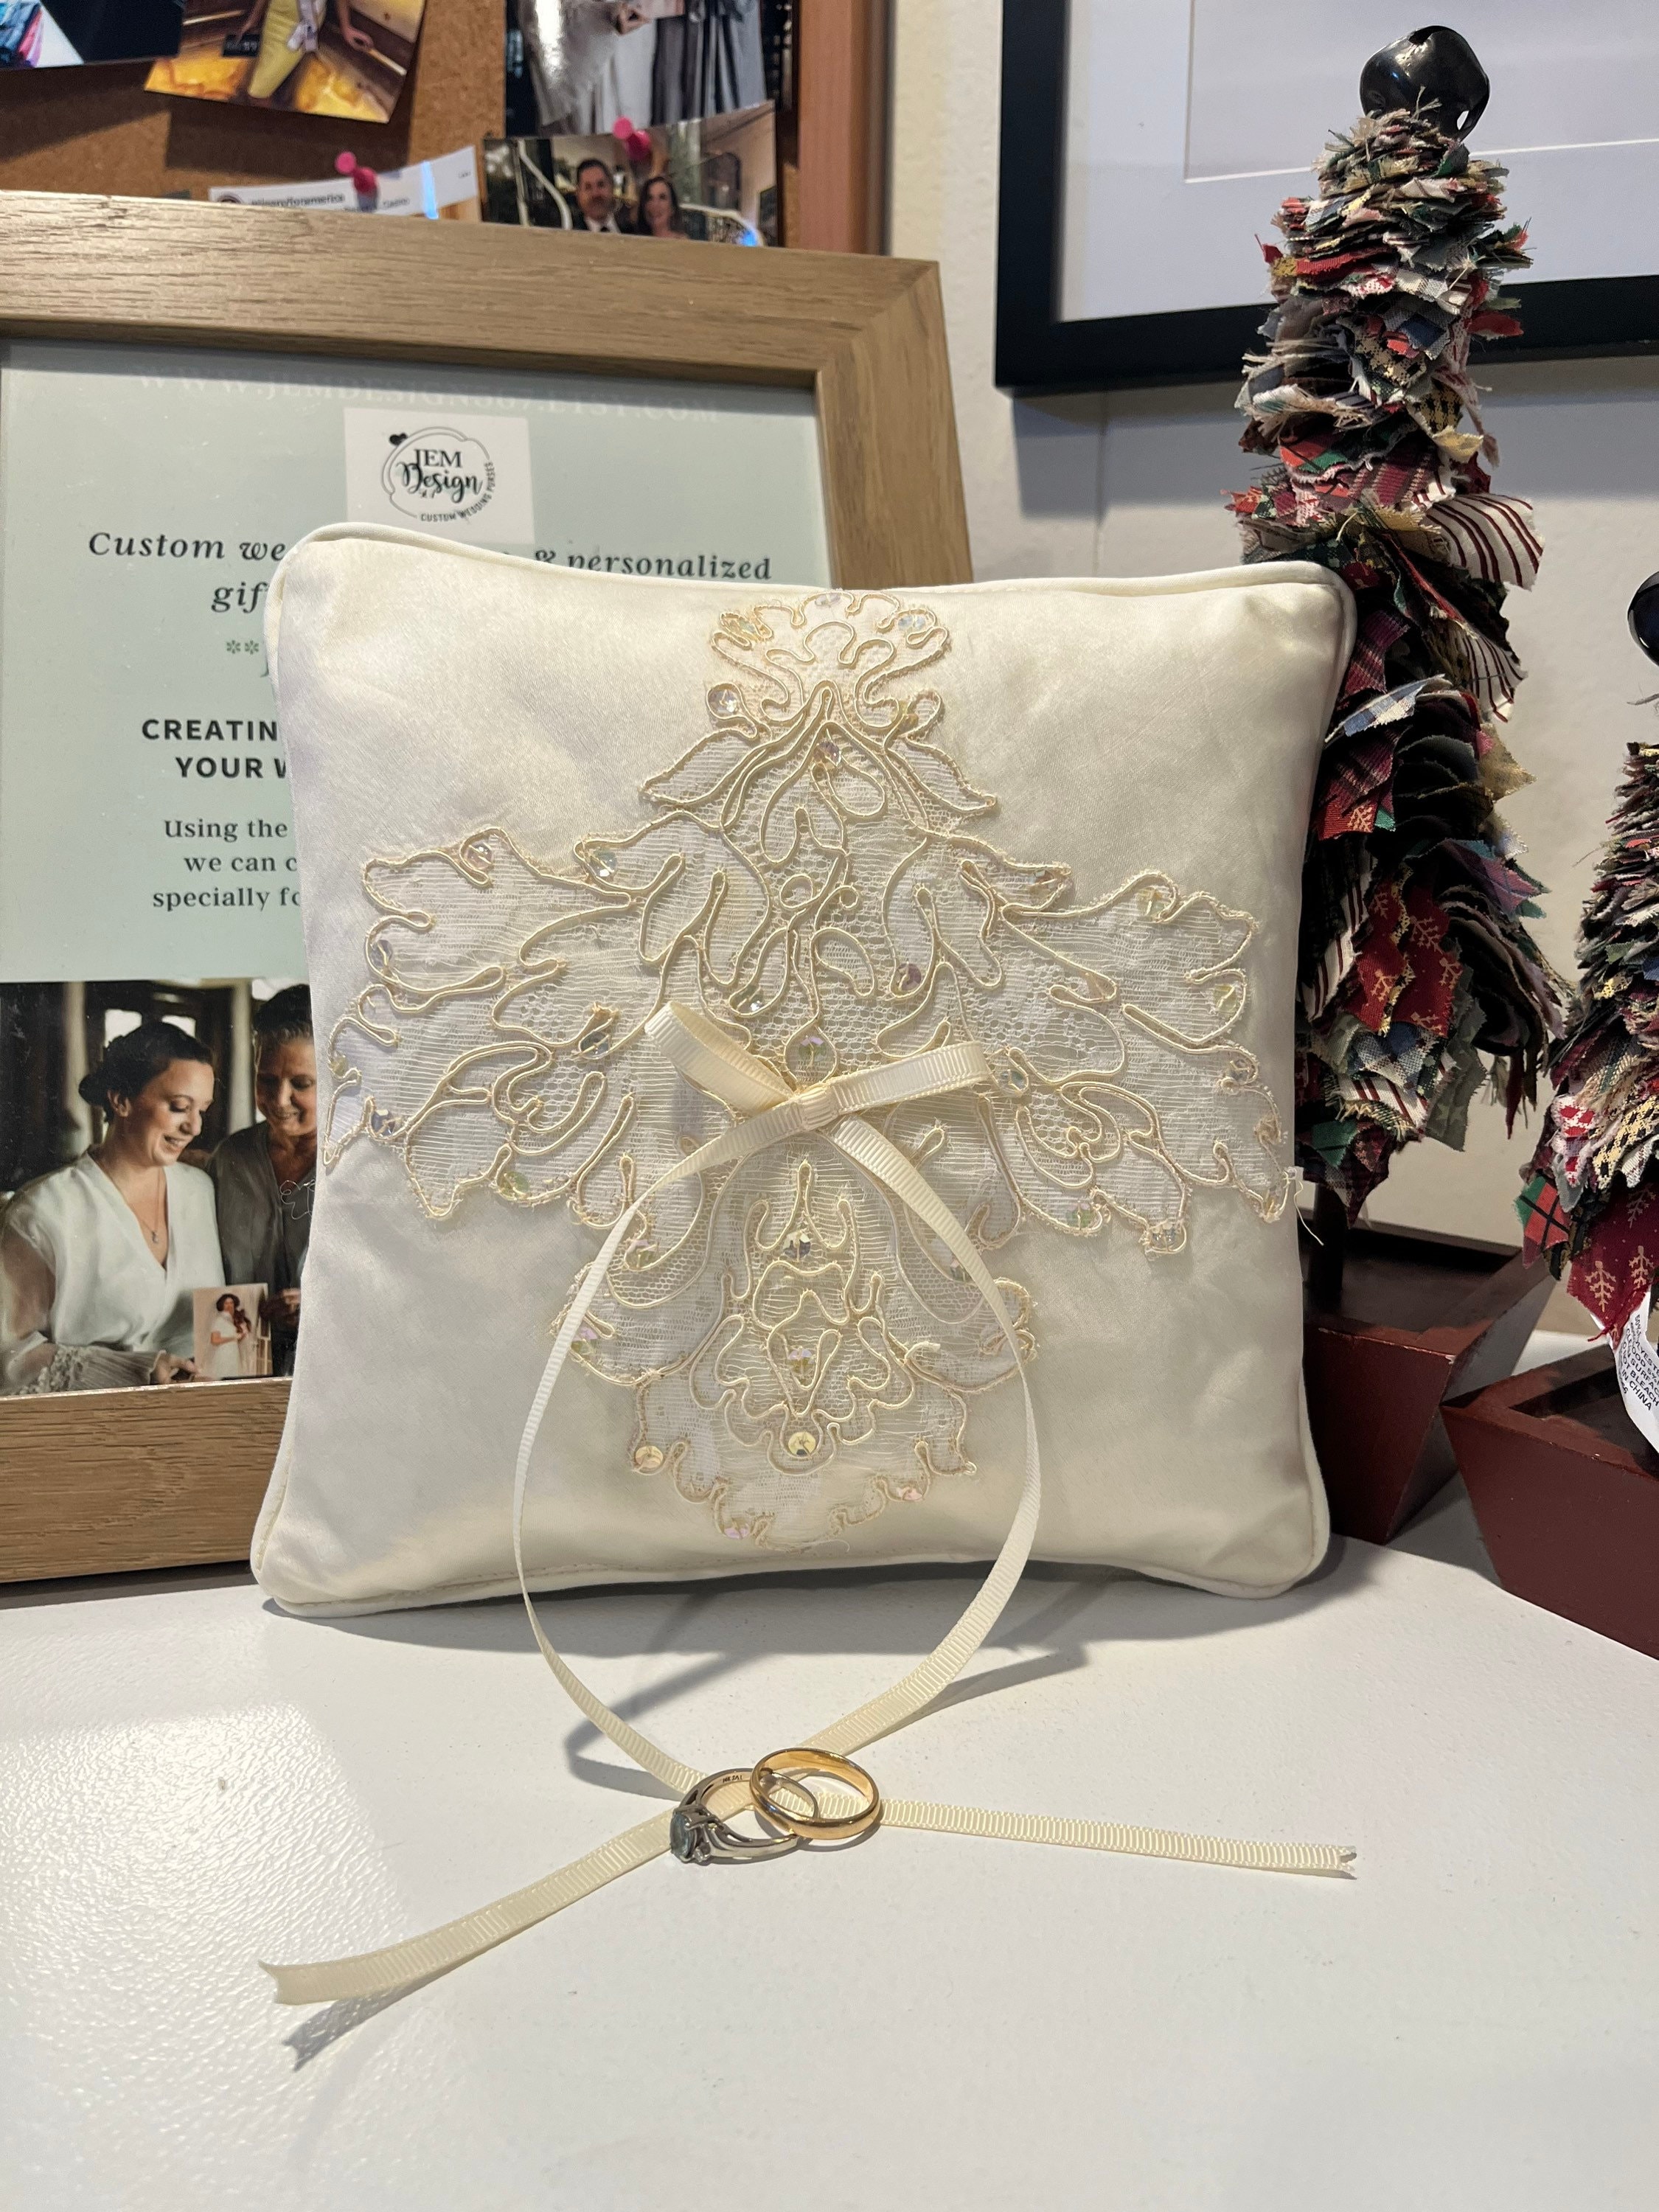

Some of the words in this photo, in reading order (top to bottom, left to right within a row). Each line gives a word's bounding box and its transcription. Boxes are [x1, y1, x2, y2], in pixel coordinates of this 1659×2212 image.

[413, 448, 463, 470] JEM
[395, 462, 483, 504] Design
[421, 512, 456, 522] CUSTOM
[457, 492, 492, 518] WEDDING
[88, 532, 225, 560] Custom
[239, 542, 286, 562] we
[142, 718, 278, 742] CREATIN
[175, 757, 264, 779] YOUR
[164, 818, 239, 843] Using
[247, 818, 288, 838] the
[184, 857, 222, 872] we
[231, 857, 276, 872] can
[152, 887, 271, 912] specially
[1629, 1380, 1652, 1411] CHINA
[1630, 1370, 1659, 1407] BLEACH
